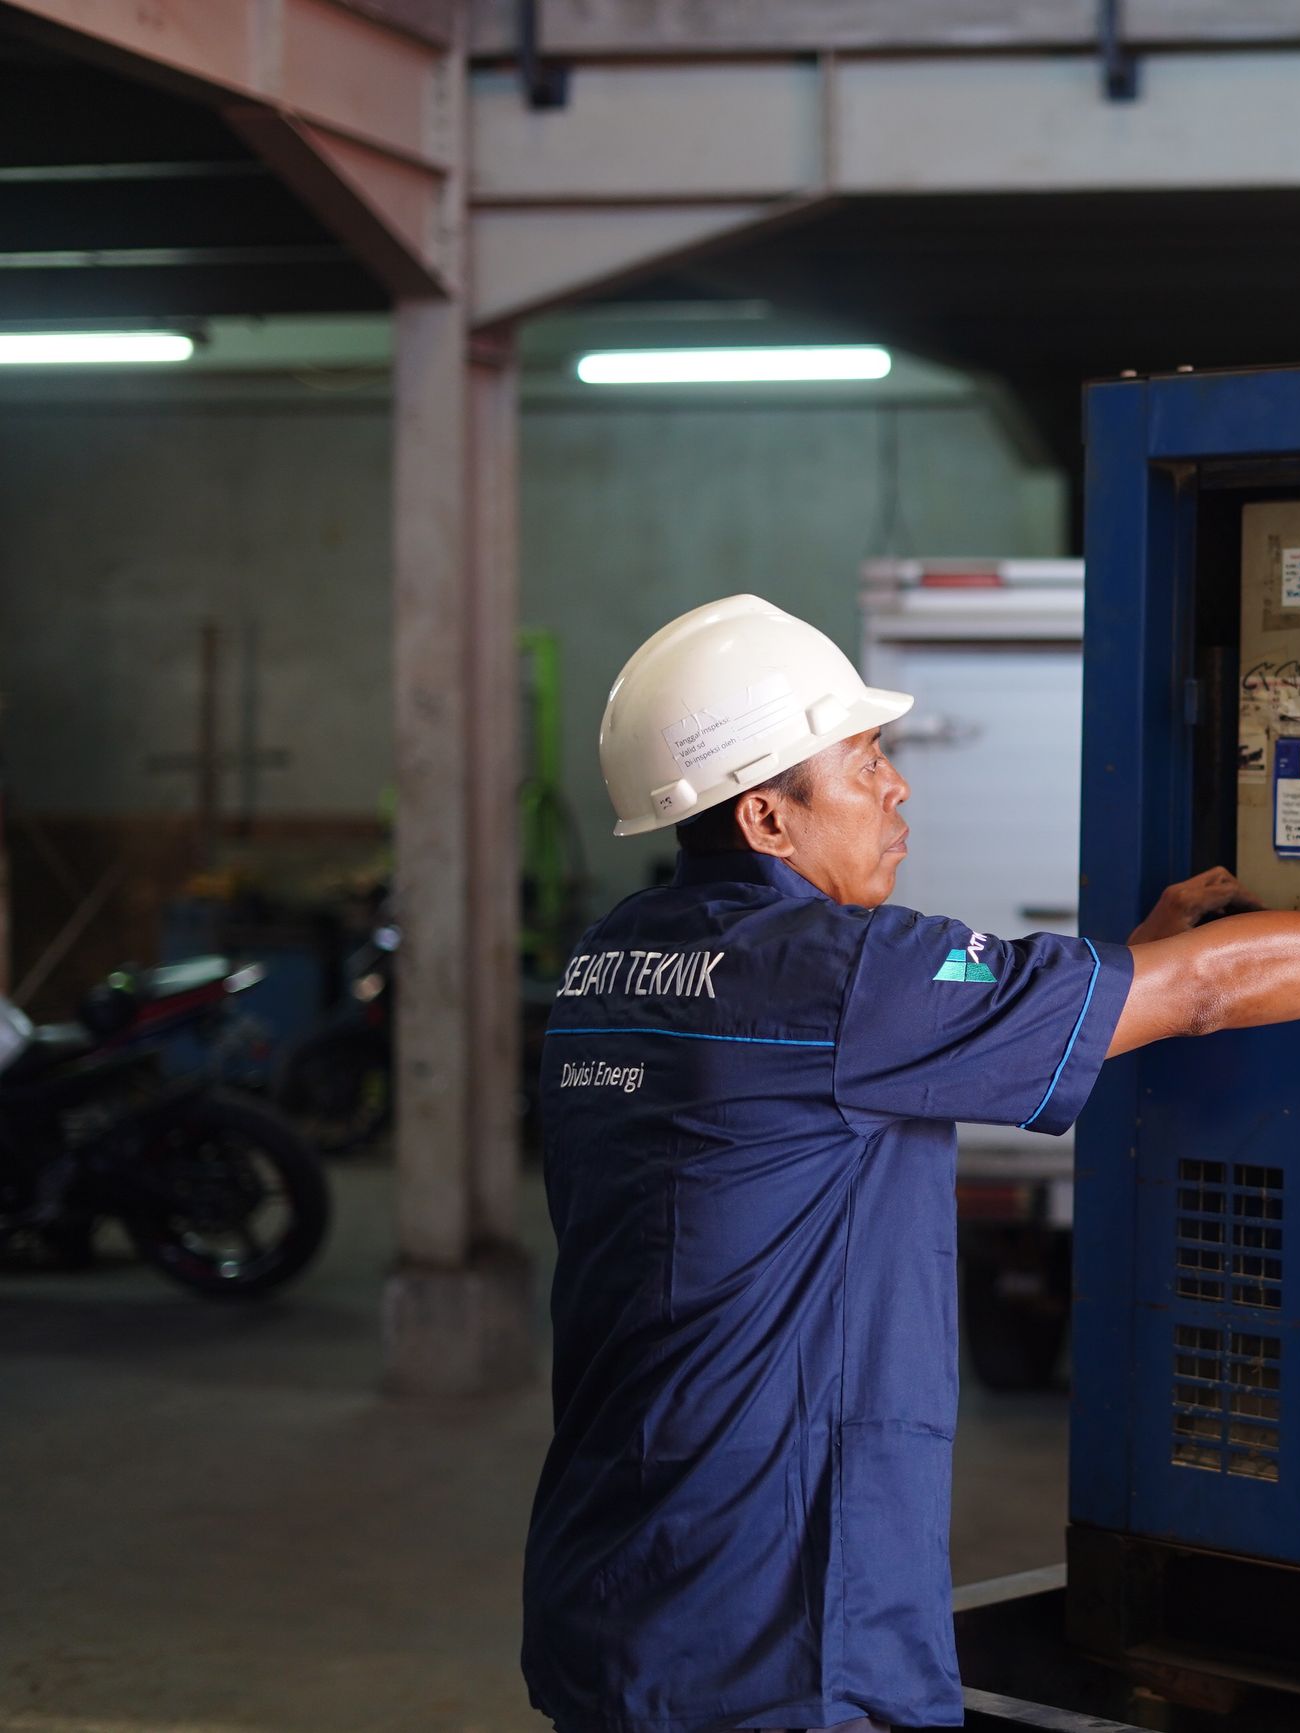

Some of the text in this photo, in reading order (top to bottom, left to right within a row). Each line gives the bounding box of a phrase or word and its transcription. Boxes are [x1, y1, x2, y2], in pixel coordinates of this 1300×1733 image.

[675, 718, 729, 748] Tanggal inspeksi
[679, 740, 705, 758] Valid sd
[684, 737, 737, 768] Di-inspeksi oleh
[556, 951, 725, 998] SEJATI TEKNIK
[560, 1060, 644, 1093] Divisi Energi
